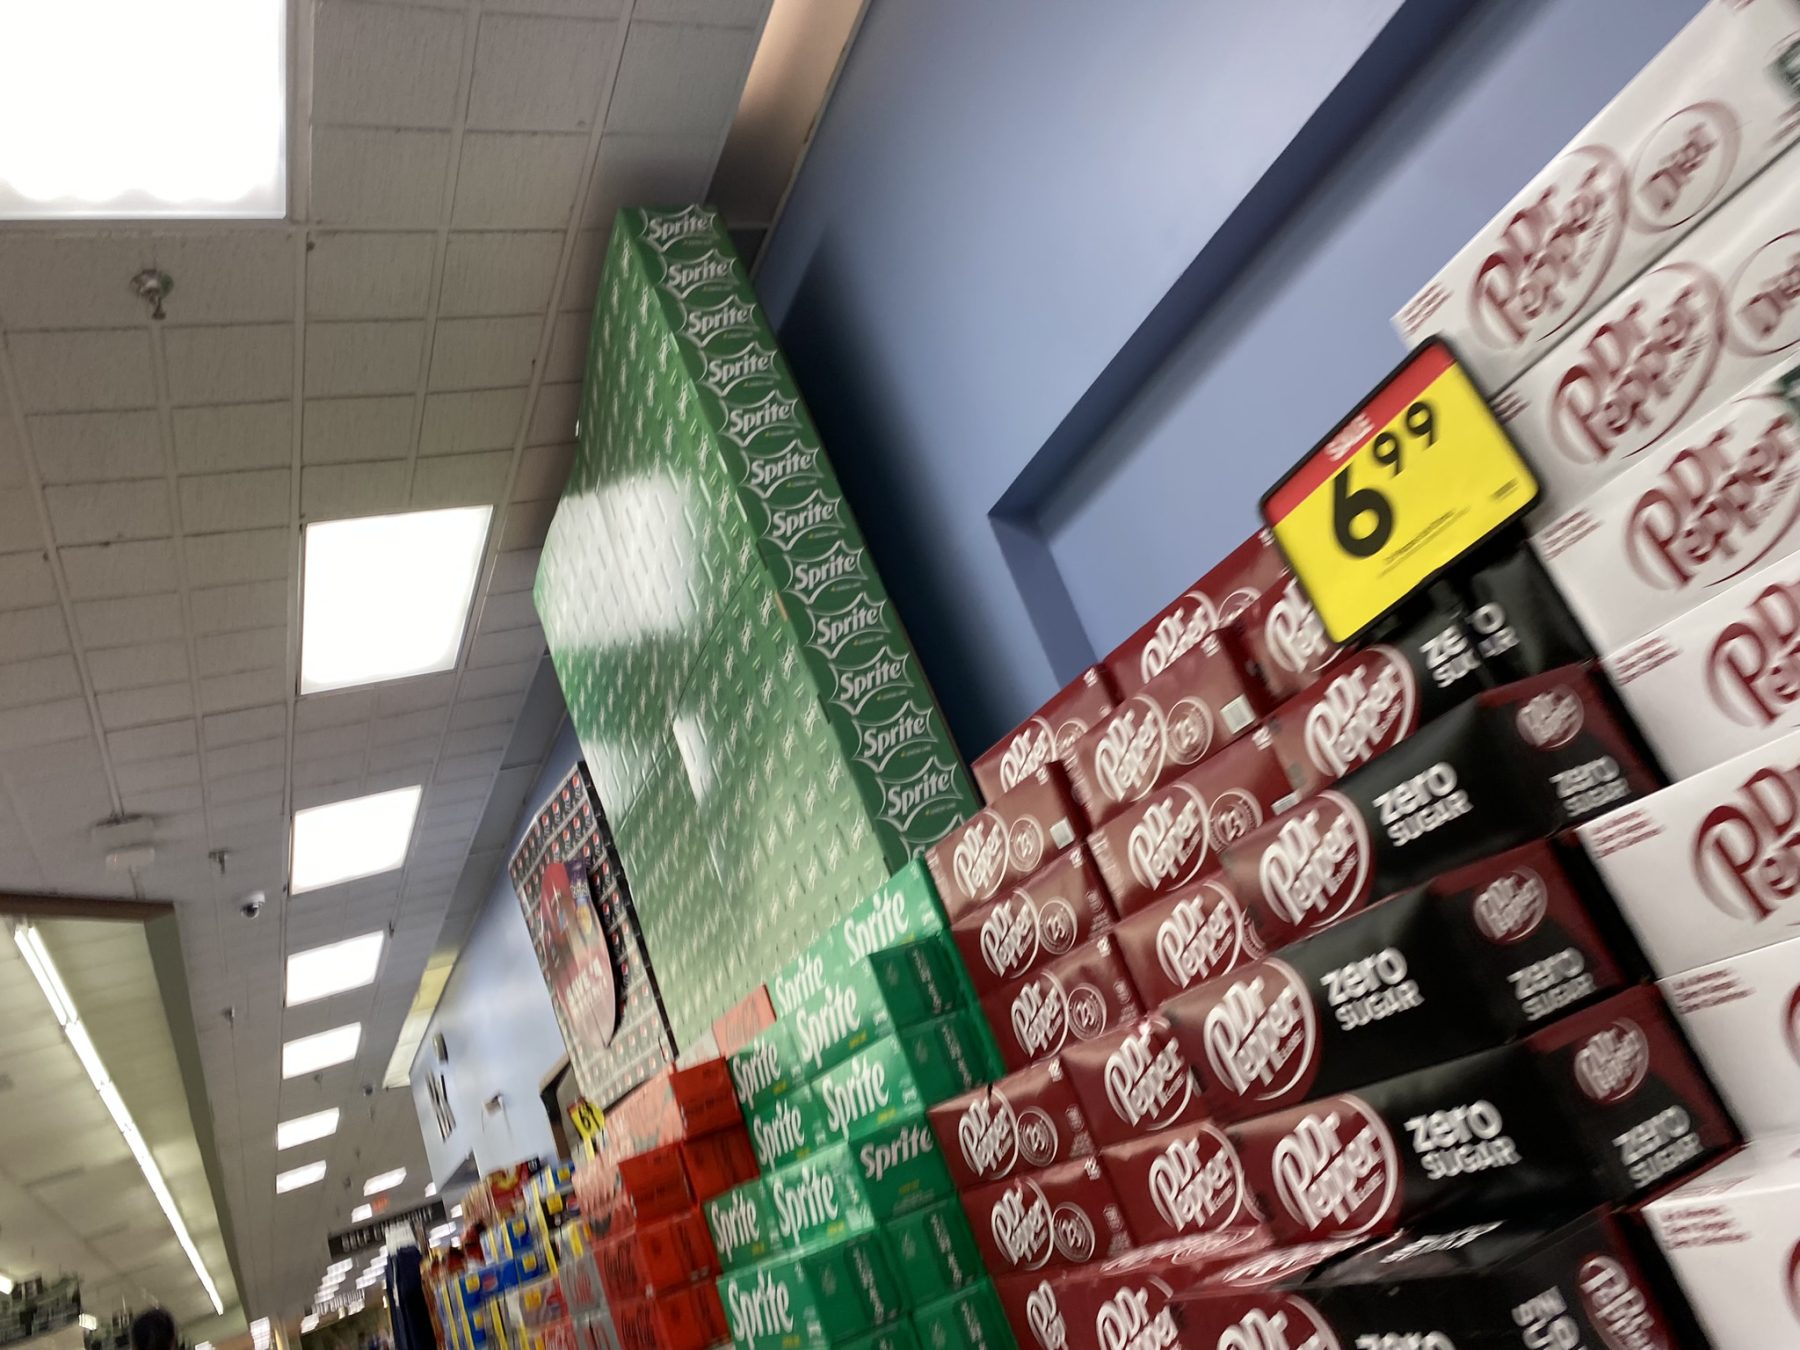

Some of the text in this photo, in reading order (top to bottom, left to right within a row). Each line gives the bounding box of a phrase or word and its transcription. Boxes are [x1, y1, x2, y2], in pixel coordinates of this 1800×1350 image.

[649, 214, 710, 243] Sprite
[1468, 162, 1612, 345] Pepper
[1498, 184, 1560, 265] Dr
[667, 262, 729, 289] Sprite
[689, 306, 752, 335] Sprite
[1582, 300, 1646, 378] Dr
[708, 352, 771, 381] Sprite
[1548, 284, 1704, 463] Pepper
[729, 403, 791, 433] Sprite
[751, 452, 813, 483] Sprite
[1660, 422, 1733, 508] Dr
[772, 502, 835, 535] Sprite
[1625, 412, 1798, 590] Pepper
[795, 555, 857, 590] Sprite
[817, 605, 879, 643] Sprite
[1419, 602, 1506, 670] zeo
[1432, 624, 1520, 688] SUAR
[840, 659, 902, 702] Sprite
[1324, 664, 1368, 730] Dr
[864, 712, 927, 757] Sprite
[1107, 708, 1136, 752] Dr
[1304, 661, 1404, 778] Pepper
[1095, 709, 1158, 800] Pepper
[887, 768, 951, 819] Sprite
[1141, 797, 1173, 846] Dr
[1387, 789, 1474, 847] SUGAR
[953, 824, 1001, 898] Pepper
[962, 822, 984, 861] Dr
[1129, 798, 1198, 891] Pepper
[1259, 813, 1358, 924] Pepper
[1278, 809, 1321, 874] Dr
[844, 889, 910, 967] Sprite
[980, 902, 1031, 978] Pepper
[989, 900, 1012, 940] Dr
[1156, 905, 1232, 988] Pepper
[1167, 894, 1201, 945] Dr
[775, 951, 829, 1016] Sprite
[1019, 981, 1042, 1021] Dr
[1224, 976, 1266, 1043] Dr
[1335, 978, 1426, 1031] SUGAR
[796, 981, 861, 1068] Sprite
[1011, 986, 1062, 1058] Pepper
[1117, 1024, 1152, 1076] Dr
[1203, 986, 1304, 1096] Pepper
[731, 1038, 782, 1107] Sprite
[823, 1056, 890, 1139] Sprite
[1104, 1036, 1183, 1127] Pepper
[753, 1099, 806, 1171] Sprite
[859, 1121, 934, 1182] Sprite
[958, 1104, 1014, 1177] Pepper
[968, 1098, 991, 1138] Dr
[1292, 1111, 1341, 1179] Dr
[1148, 1150, 1232, 1233] Pepper
[1164, 1137, 1200, 1185] Dr
[1272, 1123, 1385, 1231] Pepper
[1421, 1136, 1522, 1180] SUGAR
[711, 1189, 760, 1262] Sprite
[773, 1159, 839, 1244] Sprite
[991, 1191, 1047, 1266] Pepper
[1000, 1183, 1026, 1223] Dr
[728, 1266, 794, 1350] Sprite
